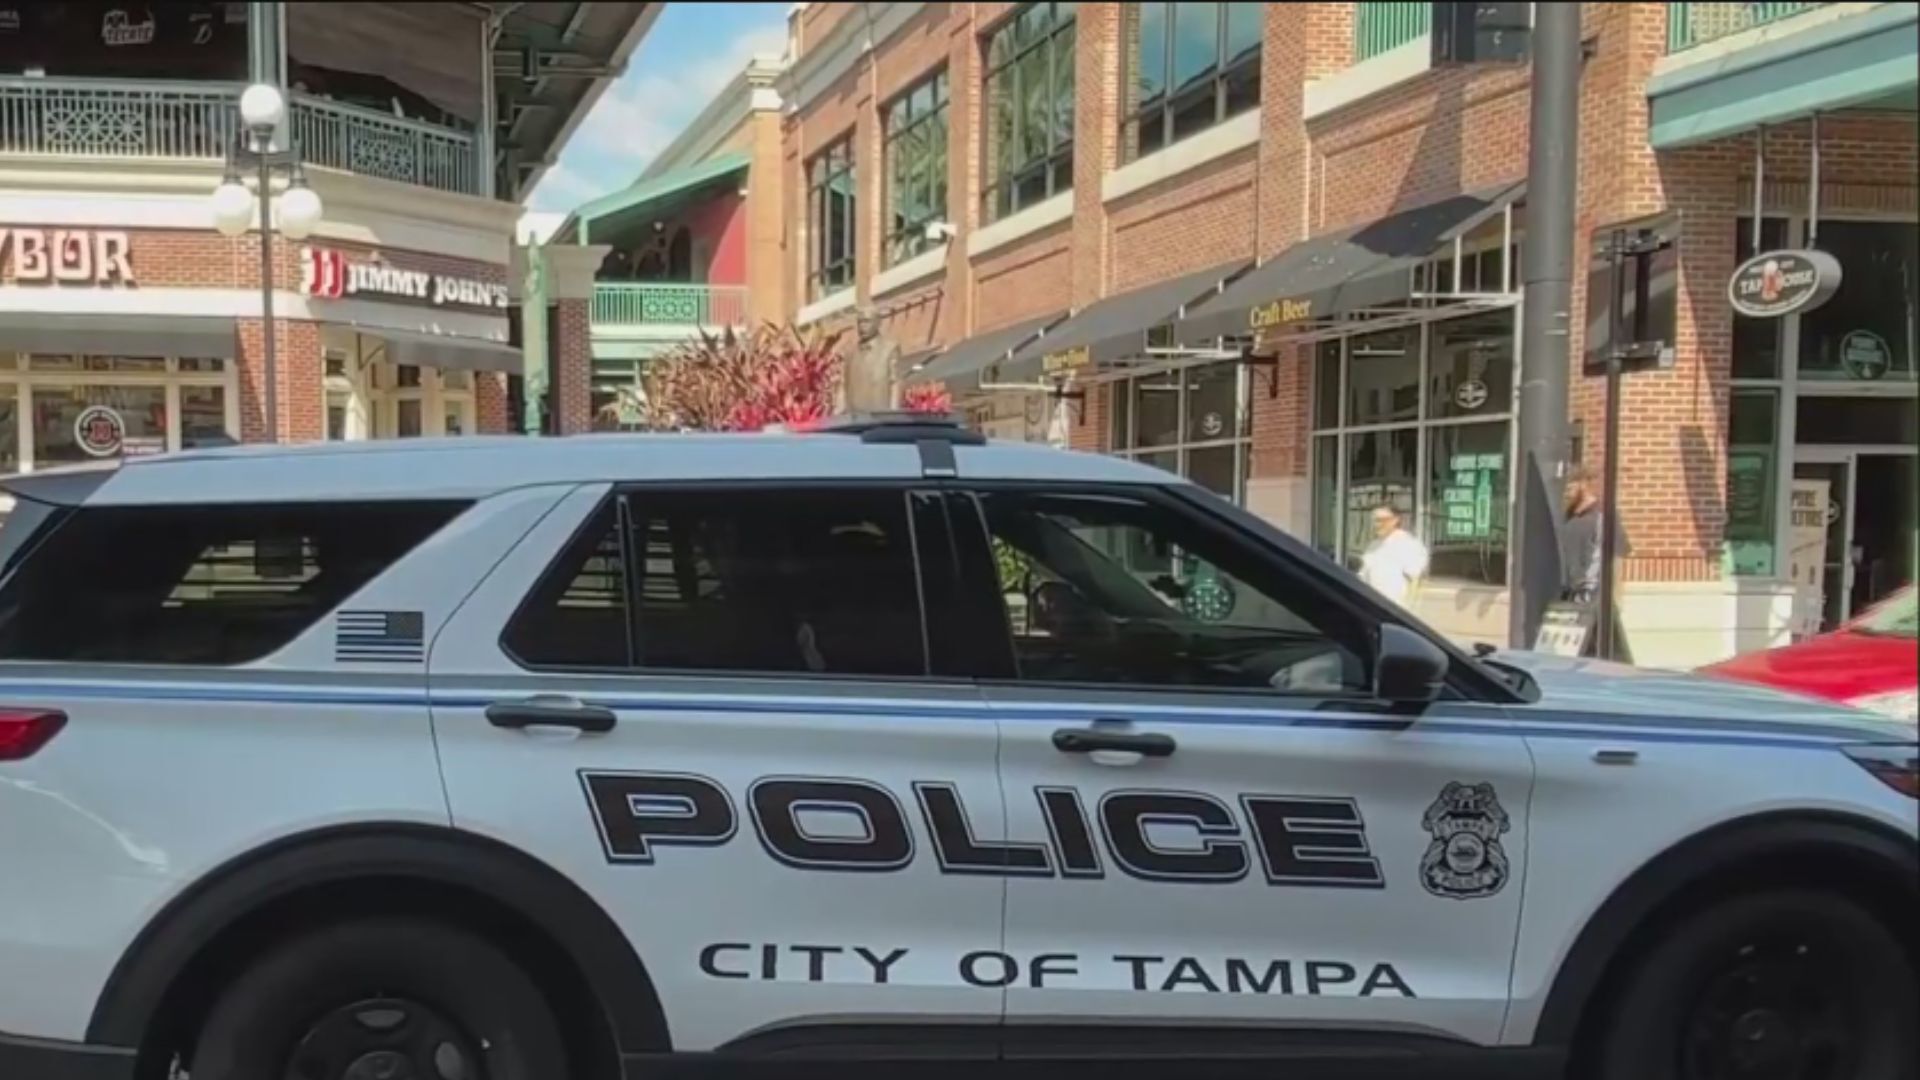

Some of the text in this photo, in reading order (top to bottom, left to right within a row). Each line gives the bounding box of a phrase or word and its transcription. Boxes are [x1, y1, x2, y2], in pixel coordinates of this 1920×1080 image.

[347, 264, 429, 297] JIMMY
[433, 275, 509, 307] JOHN'S
[1741, 279, 1763, 295] TAP
[1250, 298, 1311, 327] Craft Beer
[576, 767, 1386, 889] POLICE
[698, 942, 1416, 998] CITY OF TAMPA
